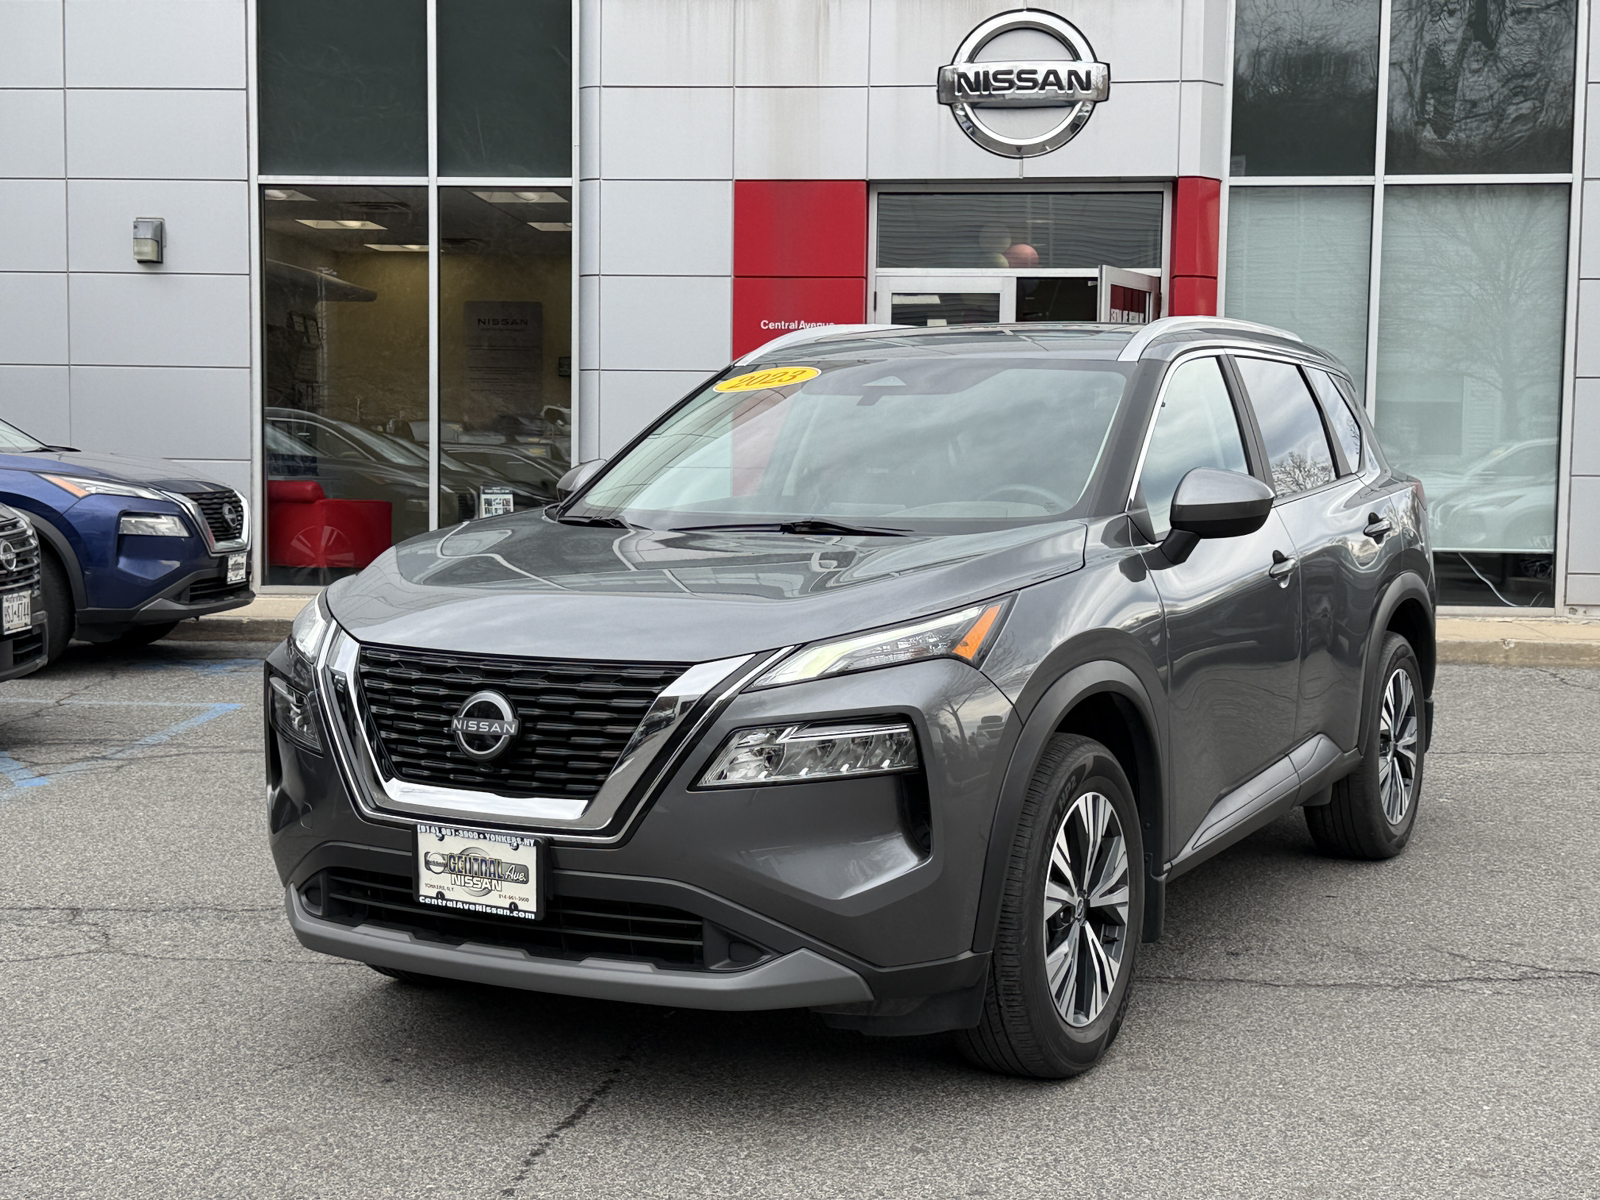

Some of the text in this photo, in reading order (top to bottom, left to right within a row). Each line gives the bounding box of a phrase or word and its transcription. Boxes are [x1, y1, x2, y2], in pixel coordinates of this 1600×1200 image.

[955, 69, 1092, 95] NISSAN
[477, 318, 529, 327] NISSAN
[760, 320, 798, 330] Central
[726, 369, 807, 390] 2023
[453, 719, 516, 733] NISSAN
[448, 853, 502, 880] CENTRAL
[451, 874, 502, 892] NISSAN
